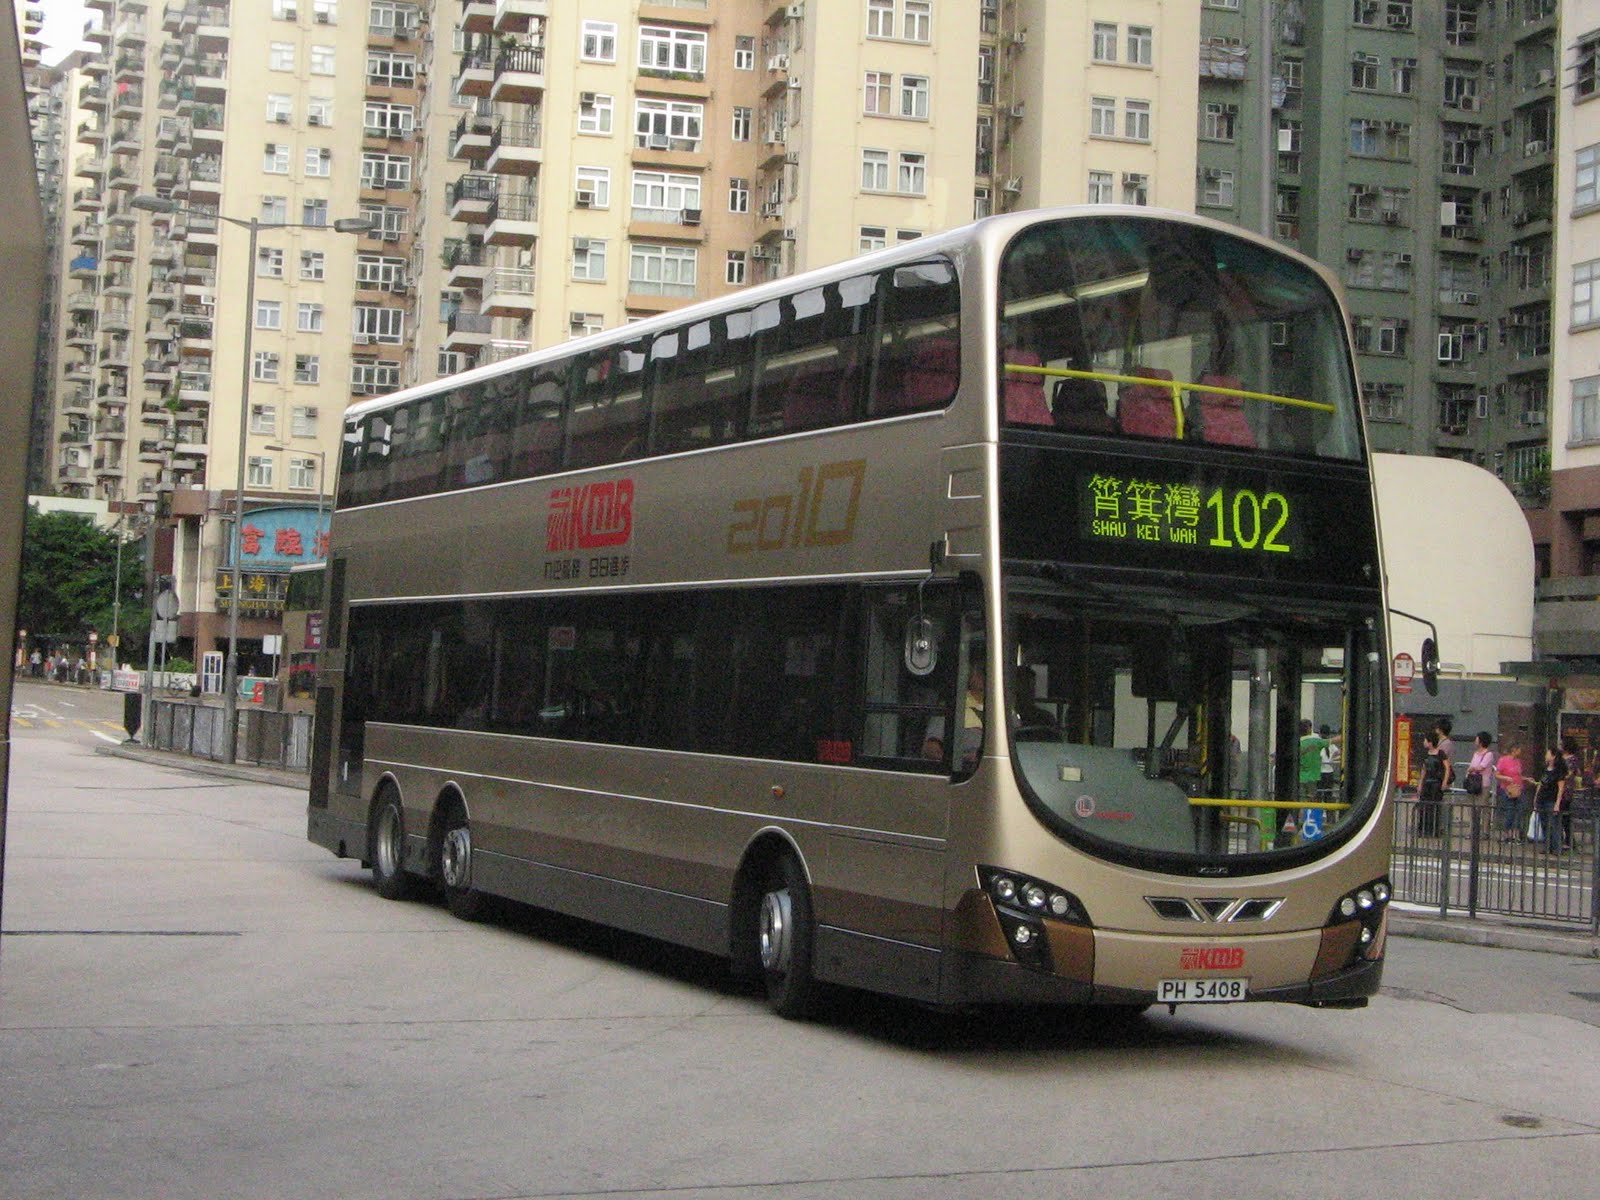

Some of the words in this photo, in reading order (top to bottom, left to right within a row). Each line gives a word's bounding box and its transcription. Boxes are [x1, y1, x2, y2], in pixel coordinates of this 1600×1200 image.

[728, 459, 866, 554] 2010
[1088, 474, 1201, 527] 筲箕灣
[1092, 522, 1127, 538] SHAU
[1136, 524, 1161, 541] KEI
[1170, 527, 1197, 544] WAN
[1207, 486, 1290, 553] 102
[219, 599, 268, 609] SHNGHAI
[1163, 981, 1187, 999] PH
[1195, 981, 1241, 999] 5408
